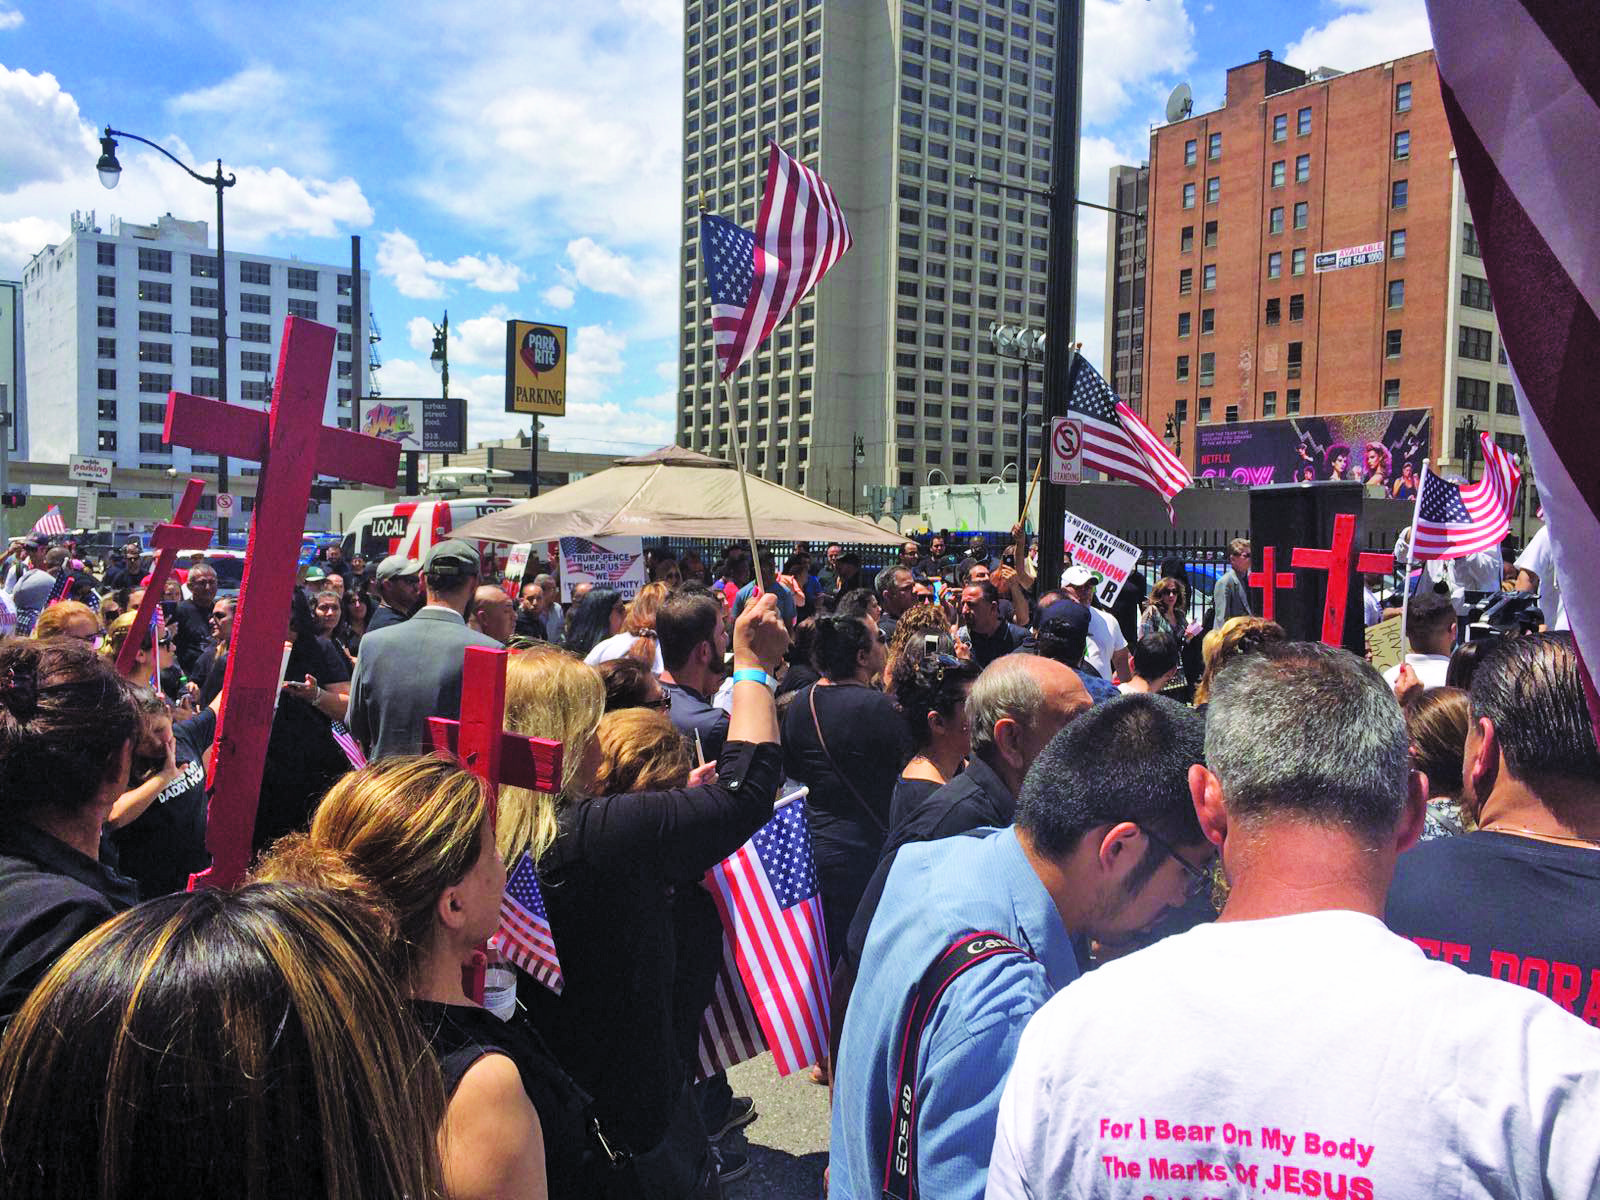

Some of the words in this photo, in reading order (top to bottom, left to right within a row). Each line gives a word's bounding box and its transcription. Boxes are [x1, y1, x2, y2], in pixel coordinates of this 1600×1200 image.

[1339, 242, 1383, 257] AVAILABLE
[1340, 257, 1352, 268] 248
[1353, 254, 1366, 266] 540
[528, 333, 556, 351] PARK
[534, 349, 556, 366] RITE
[516, 386, 562, 406] PARKING
[1061, 463, 1072, 471] NO
[1201, 453, 1231, 465] NETFLIX
[73, 463, 108, 475] parking
[1053, 472, 1080, 481] STANDING
[372, 518, 405, 536] LOCAL
[1074, 530, 1098, 551] HE'S
[1096, 542, 1116, 560] MY
[1080, 522, 1104, 540] LONGER
[1103, 533, 1110, 543] A
[1108, 539, 1138, 559] CRIMINAL
[572, 553, 631, 562] TRUMP-PENCE
[1075, 548, 1127, 583] MARROW
[583, 563, 606, 572] HEAR
[608, 563, 619, 571] US
[595, 572, 609, 581] WE
[158, 779, 190, 804] DADDY
[902, 1084, 912, 1115] 6D
[896, 1117, 909, 1176] EOS
[1100, 1119, 1133, 1140] For
[1139, 1118, 1147, 1140] I
[1155, 1119, 1216, 1142] Bear
[1222, 1123, 1253, 1147] On
[1261, 1127, 1296, 1156] My
[1304, 1132, 1375, 1168] Body
[1102, 1156, 1141, 1179] The
[1149, 1158, 1228, 1182] Marks
[1235, 1163, 1259, 1188] Of
[1265, 1164, 1375, 1200] JESUS
